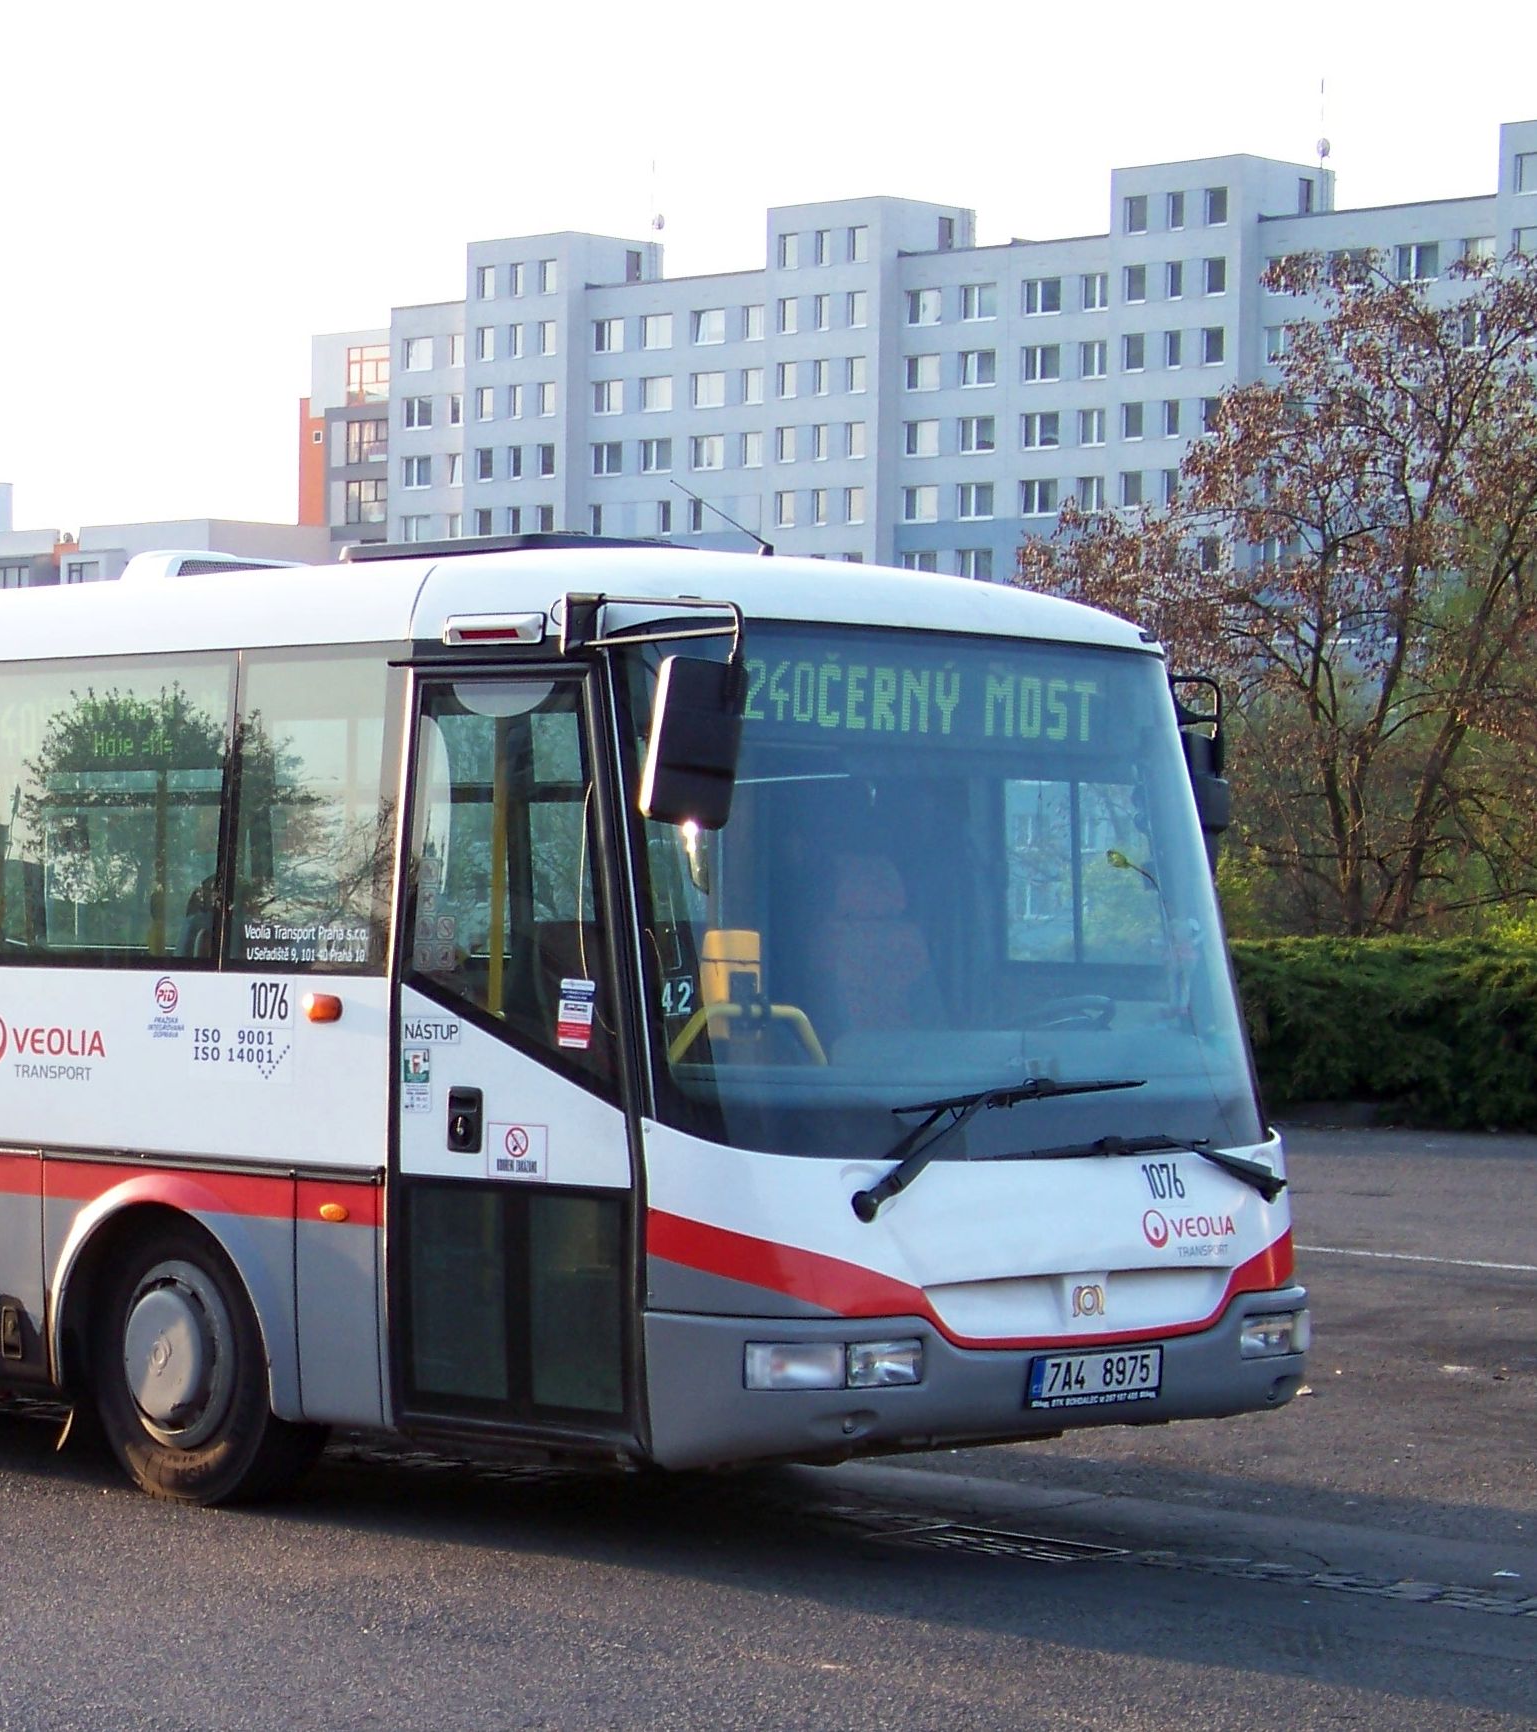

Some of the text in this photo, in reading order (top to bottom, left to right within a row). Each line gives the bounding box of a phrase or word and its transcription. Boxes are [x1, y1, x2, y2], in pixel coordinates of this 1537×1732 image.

[743, 652, 1097, 742] 240 ČERNÝ MOST
[244, 924, 271, 940] Veolia
[273, 925, 316, 943] Transport
[318, 925, 344, 940] Praha
[301, 947, 315, 961] 101
[250, 981, 289, 1021] 1076
[194, 1028, 274, 1046] ISO 9001
[404, 1019, 459, 1041] NÁSTUP
[12, 1027, 106, 1058] VEOLIA
[193, 1046, 274, 1063] ISO 14001
[13, 1063, 92, 1081] TRANSPORT
[1141, 1162, 1186, 1200] 1076
[1169, 1215, 1236, 1239] VEOLIA
[1047, 1353, 1151, 1393] 7A4 8975
